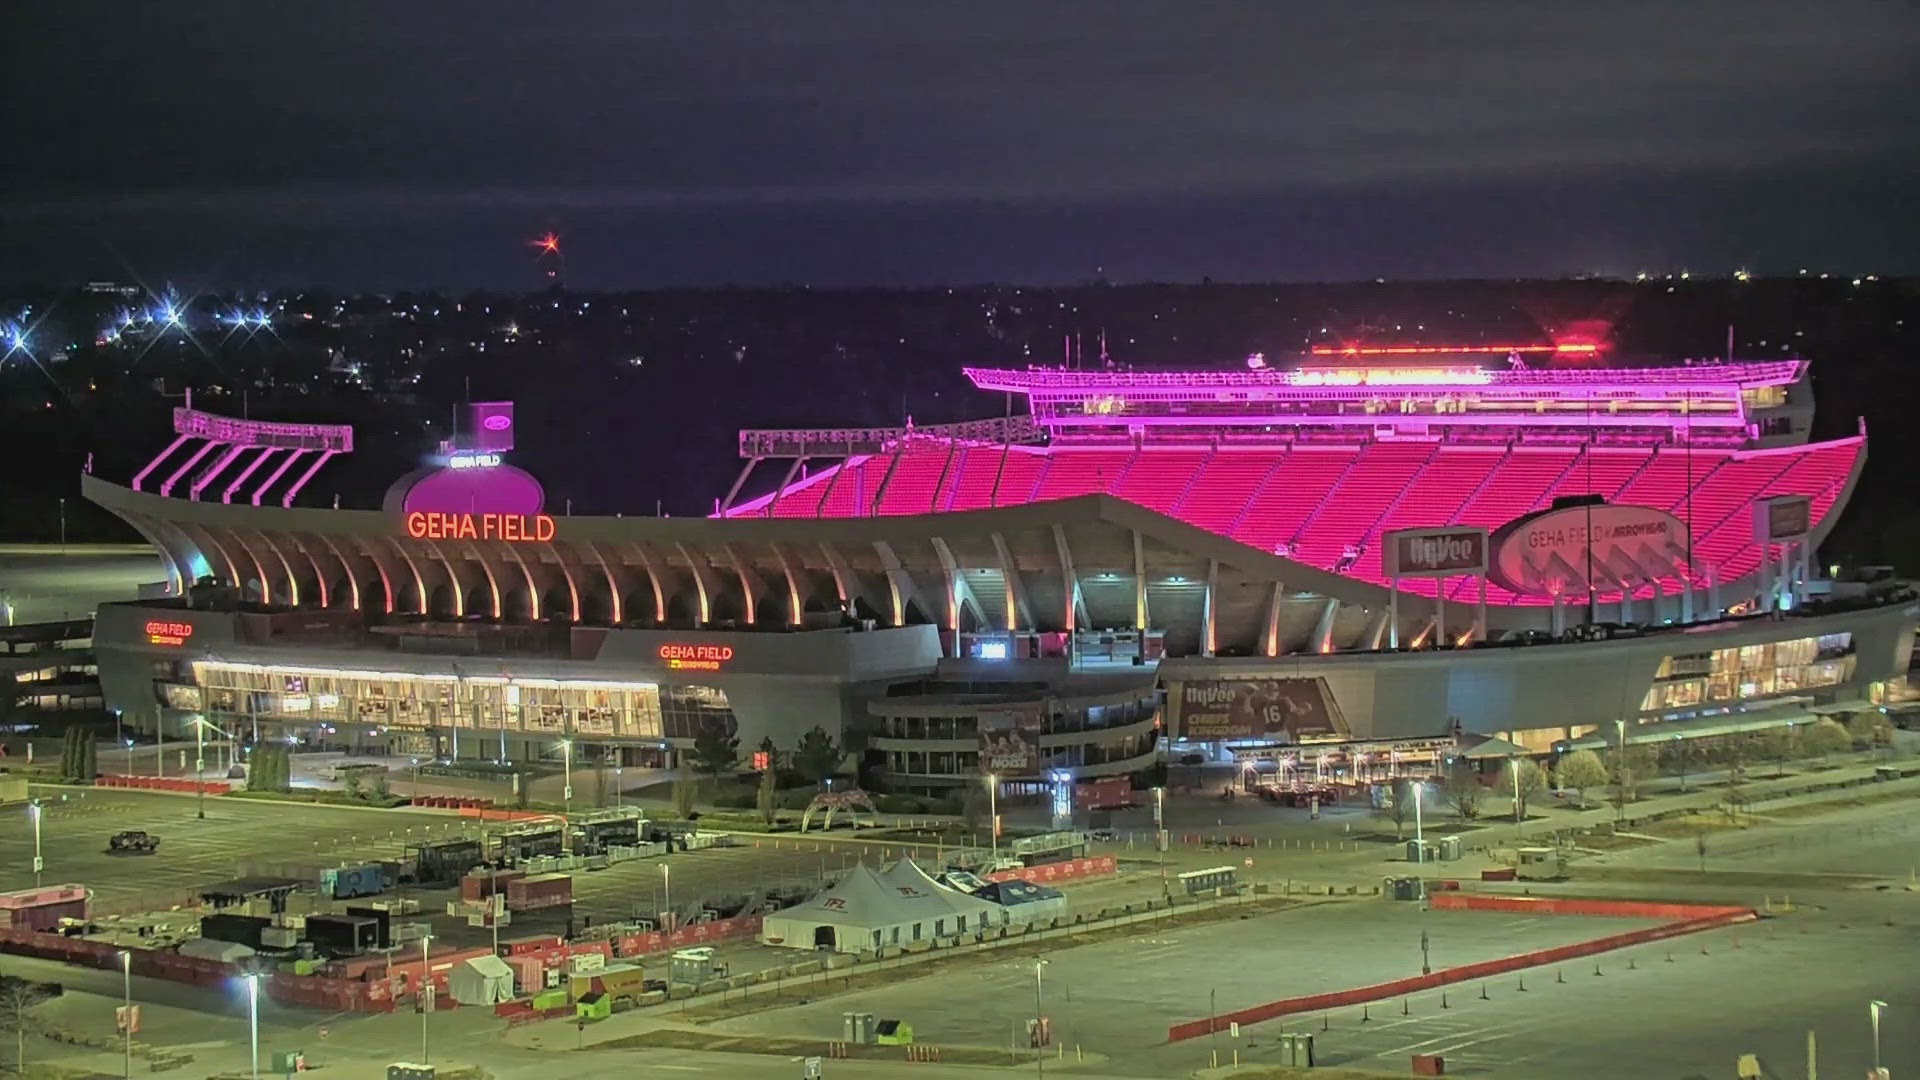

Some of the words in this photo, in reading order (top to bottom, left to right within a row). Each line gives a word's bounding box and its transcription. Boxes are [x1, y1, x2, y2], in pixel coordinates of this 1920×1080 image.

[475, 455, 501, 467] FIELD
[408, 511, 478, 540] GEHA
[483, 513, 555, 542] FIELD
[1528, 528, 1565, 548] GEHA
[1568, 526, 1603, 544] FIELD
[146, 622, 168, 635] GEHA
[168, 623, 192, 637] FIELD
[660, 645, 695, 659] GEHA
[697, 646, 733, 660] FIELD
[1263, 704, 1282, 724] 16
